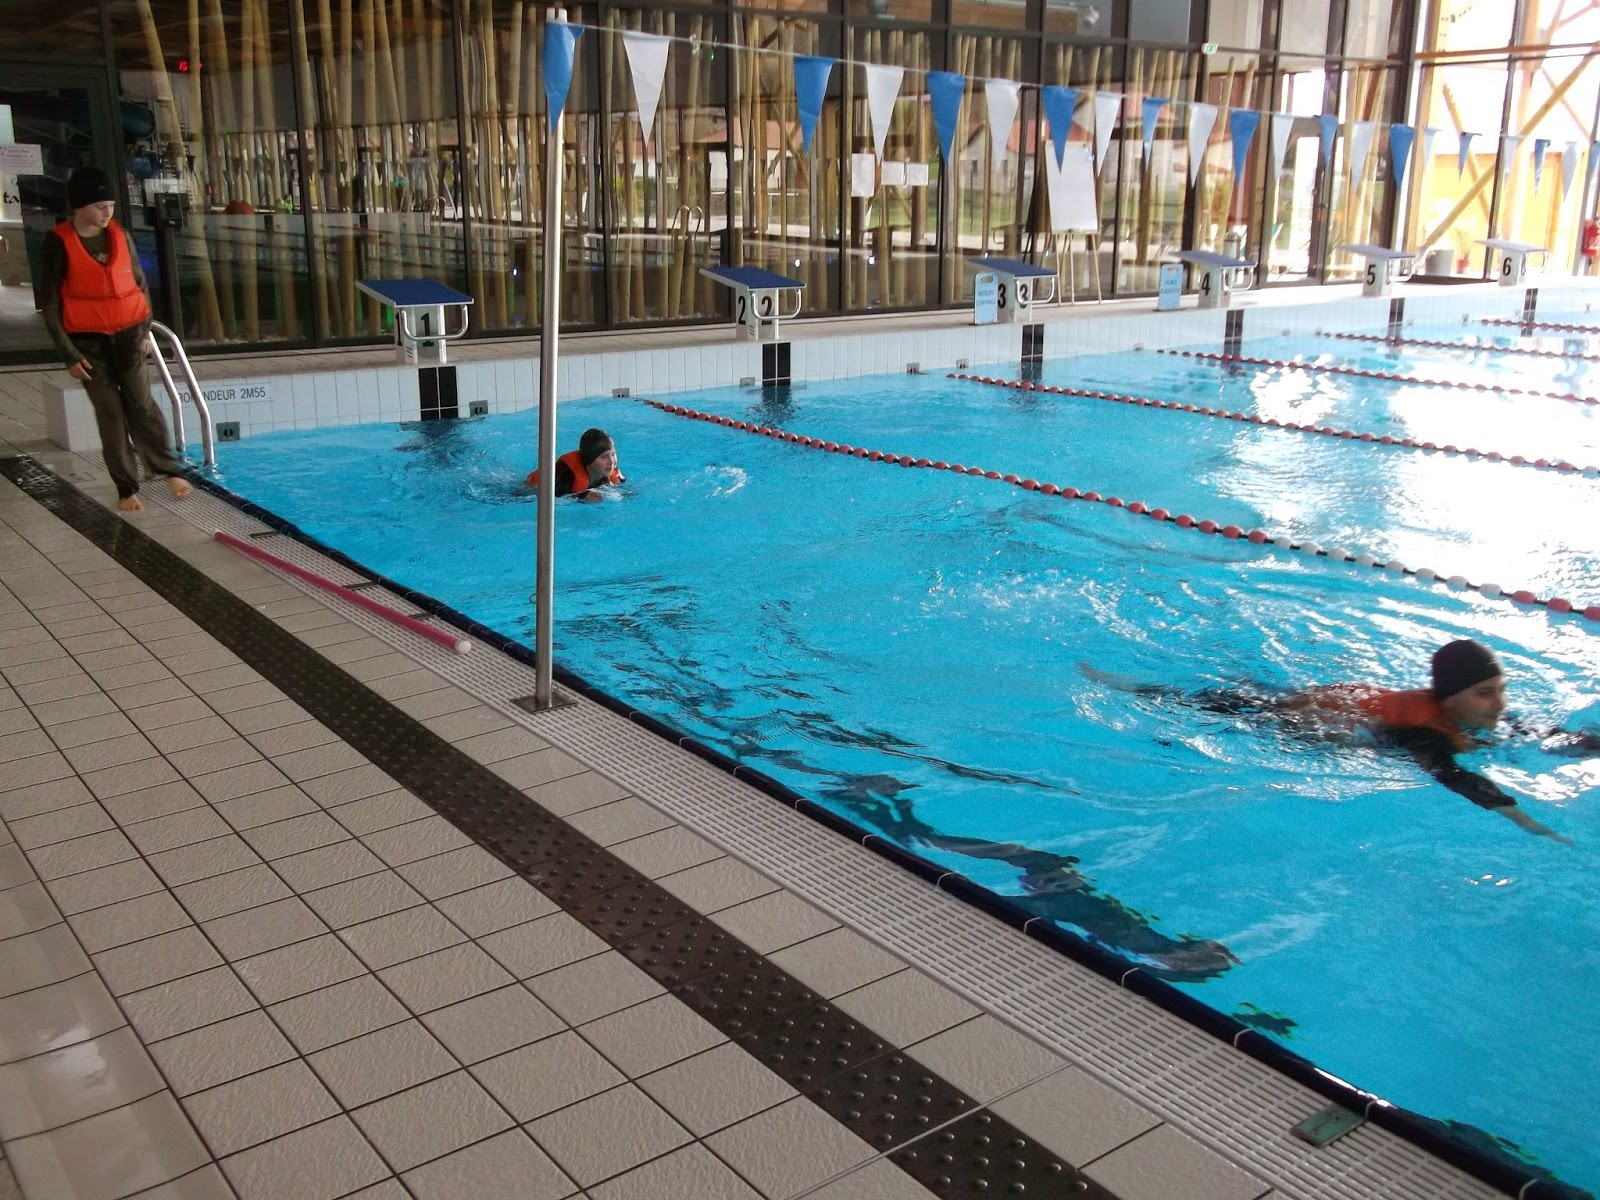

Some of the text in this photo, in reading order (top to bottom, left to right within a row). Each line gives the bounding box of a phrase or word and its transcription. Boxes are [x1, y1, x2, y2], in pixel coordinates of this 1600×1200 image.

[1366, 264, 1376, 285] 5
[1502, 257, 1512, 276] 6
[997, 283, 1007, 309] 3
[1202, 272, 1211, 296] 4
[738, 295, 746, 325] 2
[761, 295, 772, 325] 2
[420, 312, 434, 347] 1
[240, 386, 266, 399] 2M55
